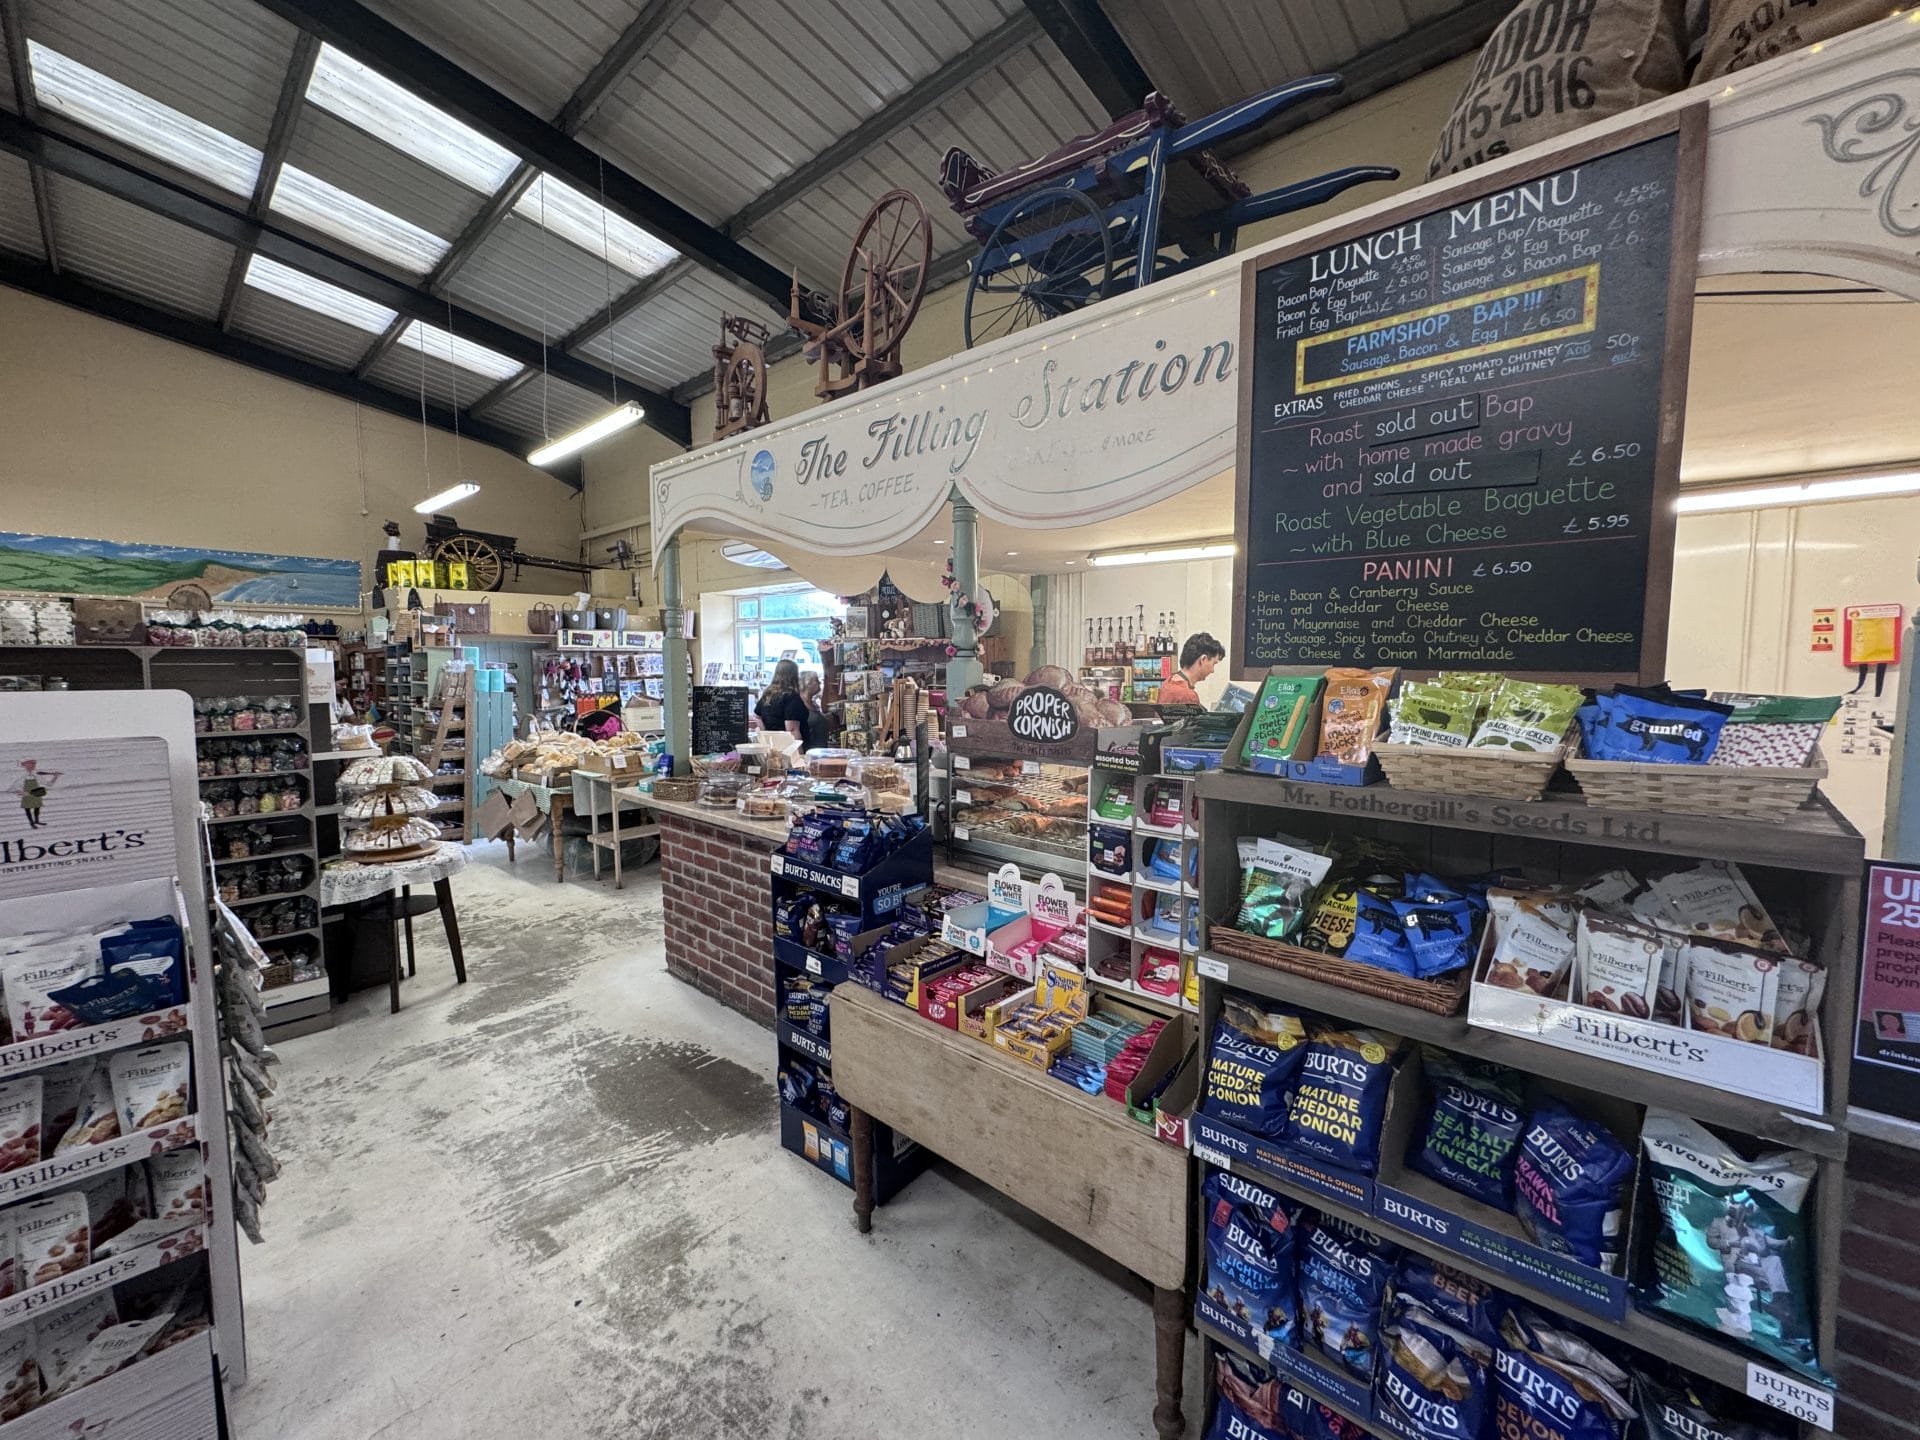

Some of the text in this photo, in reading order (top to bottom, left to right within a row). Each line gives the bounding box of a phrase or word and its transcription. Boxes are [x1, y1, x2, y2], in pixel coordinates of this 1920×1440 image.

[1309, 169, 1580, 283] LUNCH MENU
[1442, 237, 1493, 260] Sausage
[1497, 201, 1604, 243] Bap/Baguette
[1442, 227, 1590, 278] Sausage & Egg Bap
[1442, 243, 1602, 295] Sausage & Bacon Bap
[1278, 294, 1307, 309] Bacon
[1309, 269, 1379, 300] Bap/Baguette
[1277, 323, 1303, 339] Fried
[1309, 318, 1329, 333] Egg
[1336, 308, 1359, 325] Bap
[1278, 309, 1305, 324] Bacon
[1310, 302, 1320, 314] &
[1327, 298, 1346, 312] Egg
[1347, 314, 1450, 356] FARMSHOP
[1333, 388, 1360, 401] FRIED
[1363, 379, 1400, 394] ONIONS
[1420, 367, 1454, 384] SPICY
[1458, 358, 1503, 375] TOMATO
[1508, 344, 1564, 365] CHUTNEY
[1605, 333, 1639, 350] 50p
[1339, 394, 1382, 409] CHEDDAR
[1387, 385, 1424, 399] CHEESE
[1440, 375, 1467, 388] REAL
[1474, 370, 1495, 382] ALE
[1501, 358, 1557, 377] CHUTNEY
[795, 338, 1238, 486] The Filling Station
[1274, 396, 1323, 418] EXTRAS
[1310, 394, 1534, 447] Roast sold out Bap
[1114, 429, 1156, 448] MORE
[1305, 420, 1573, 474] with home made gravy
[1322, 473, 1362, 498] and
[1373, 462, 1416, 486] sold
[1429, 458, 1472, 482] out
[1275, 476, 1617, 533] Roast Vegetable Baguette
[1312, 532, 1353, 553] with
[1365, 529, 1411, 550] Blue
[1426, 523, 1508, 544] Cheese
[1363, 556, 1453, 582] PANINI
[1290, 589, 1323, 601] Bacon
[1329, 587, 1340, 599] &
[1350, 585, 1418, 599] Cranberry
[1428, 583, 1474, 595] Sauce
[1257, 599, 1449, 616] Ham and Cheddar Cheese
[1257, 612, 1539, 633] Tuna Mayonnaise and Cheddar Cheese
[1256, 632, 1281, 645] Pork
[1334, 632, 1366, 648] Spicy
[1371, 630, 1415, 644] tomato
[1423, 630, 1479, 647] Chutney
[1484, 630, 1498, 643] &
[1507, 628, 1571, 643] Cheddar
[1576, 627, 1634, 643] Cheese
[1299, 647, 1341, 659] Cheese
[1352, 645, 1365, 659] &
[1378, 648, 1418, 659] Onion
[1428, 646, 1516, 660] Marmalade
[1016, 692, 1070, 719] PROPER
[1013, 715, 1072, 740] CORNISH
[1254, 727, 1282, 739] sticks
[1324, 735, 1356, 750] sticks
[1432, 732, 1463, 746] PICKLES
[1629, 717, 1704, 743] gruntled
[1095, 754, 1140, 766] assorted box
[1283, 785, 1672, 845] Mr. Fothergill's Seeds Ltd.
[2, 855, 114, 874] INTERESTING SNACKS
[785, 863, 842, 889] BURTS SNACKS
[1256, 856, 1312, 877] SAVOURSMITHS
[878, 899, 890, 910] SO
[1038, 895, 1068, 909] FLOWER
[1047, 905, 1069, 917] WHITE
[1704, 970, 1757, 993] Filbert's
[0, 1028, 118, 1066] Filbert's
[1216, 1033, 1280, 1063] BURTS
[127, 1061, 182, 1078] Filbert's
[1208, 1071, 1261, 1093] CHEDDAR
[1212, 1058, 1266, 1084] MATURE
[1303, 1052, 1368, 1083] BURTS
[1208, 1085, 1261, 1106] & ONION
[1299, 1084, 1360, 1113] MATURE
[1289, 1110, 1357, 1145] & ONION
[1293, 1096, 1363, 1131] CHEDDAR
[1201, 1126, 1248, 1153] BURTS
[1433, 1109, 1514, 1153] SEA SALT
[1435, 1128, 1502, 1164] & MALT
[10, 1146, 127, 1190] Filbert's
[1426, 1135, 1502, 1180] VINEGAR
[1218, 1172, 1276, 1209] BURTS
[17, 1211, 81, 1234] Filbert's
[1384, 1197, 1449, 1234] BURTS
[23, 1256, 139, 1310] Filbert's
[1226, 1254, 1272, 1284] LIGHTLY
[1200, 1301, 1247, 1337] BURTS
[1755, 1371, 1830, 1412] BURTS
[1763, 1393, 1818, 1424] £2.09
